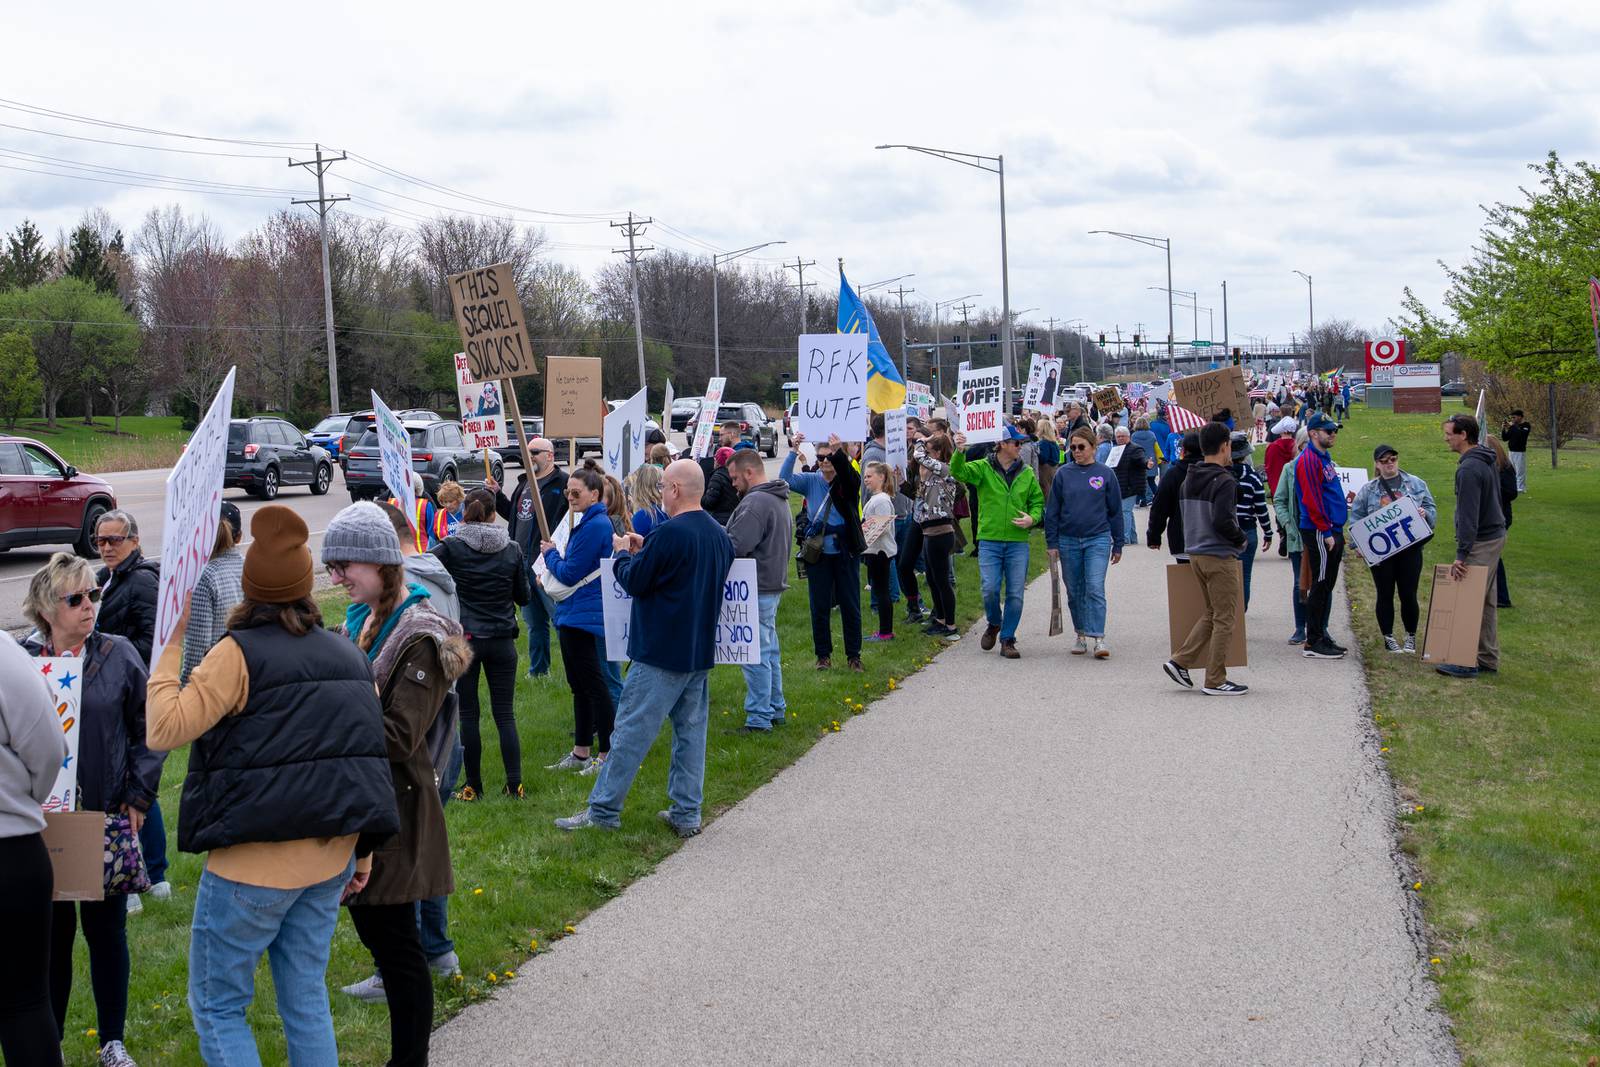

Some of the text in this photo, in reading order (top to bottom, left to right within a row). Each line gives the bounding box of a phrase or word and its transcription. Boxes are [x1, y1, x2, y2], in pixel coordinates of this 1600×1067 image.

[455, 269, 499, 300] THIS
[462, 300, 518, 338] SEQUEL
[467, 333, 528, 380] SUCKS!
[808, 348, 863, 385] RFK
[962, 375, 1000, 390] HANDS
[1181, 375, 1221, 397] HANDS
[806, 396, 862, 421] WTF
[962, 386, 1000, 411] OFF!
[1195, 391, 1218, 408] OFF
[484, 420, 496, 432] AND
[966, 410, 996, 432] SCIENCE
[1363, 504, 1402, 532] HANDS
[1368, 515, 1415, 556] OFF
[159, 490, 218, 646] CRISIS
[724, 580, 749, 601] OUR
[729, 625, 753, 643] OUR
